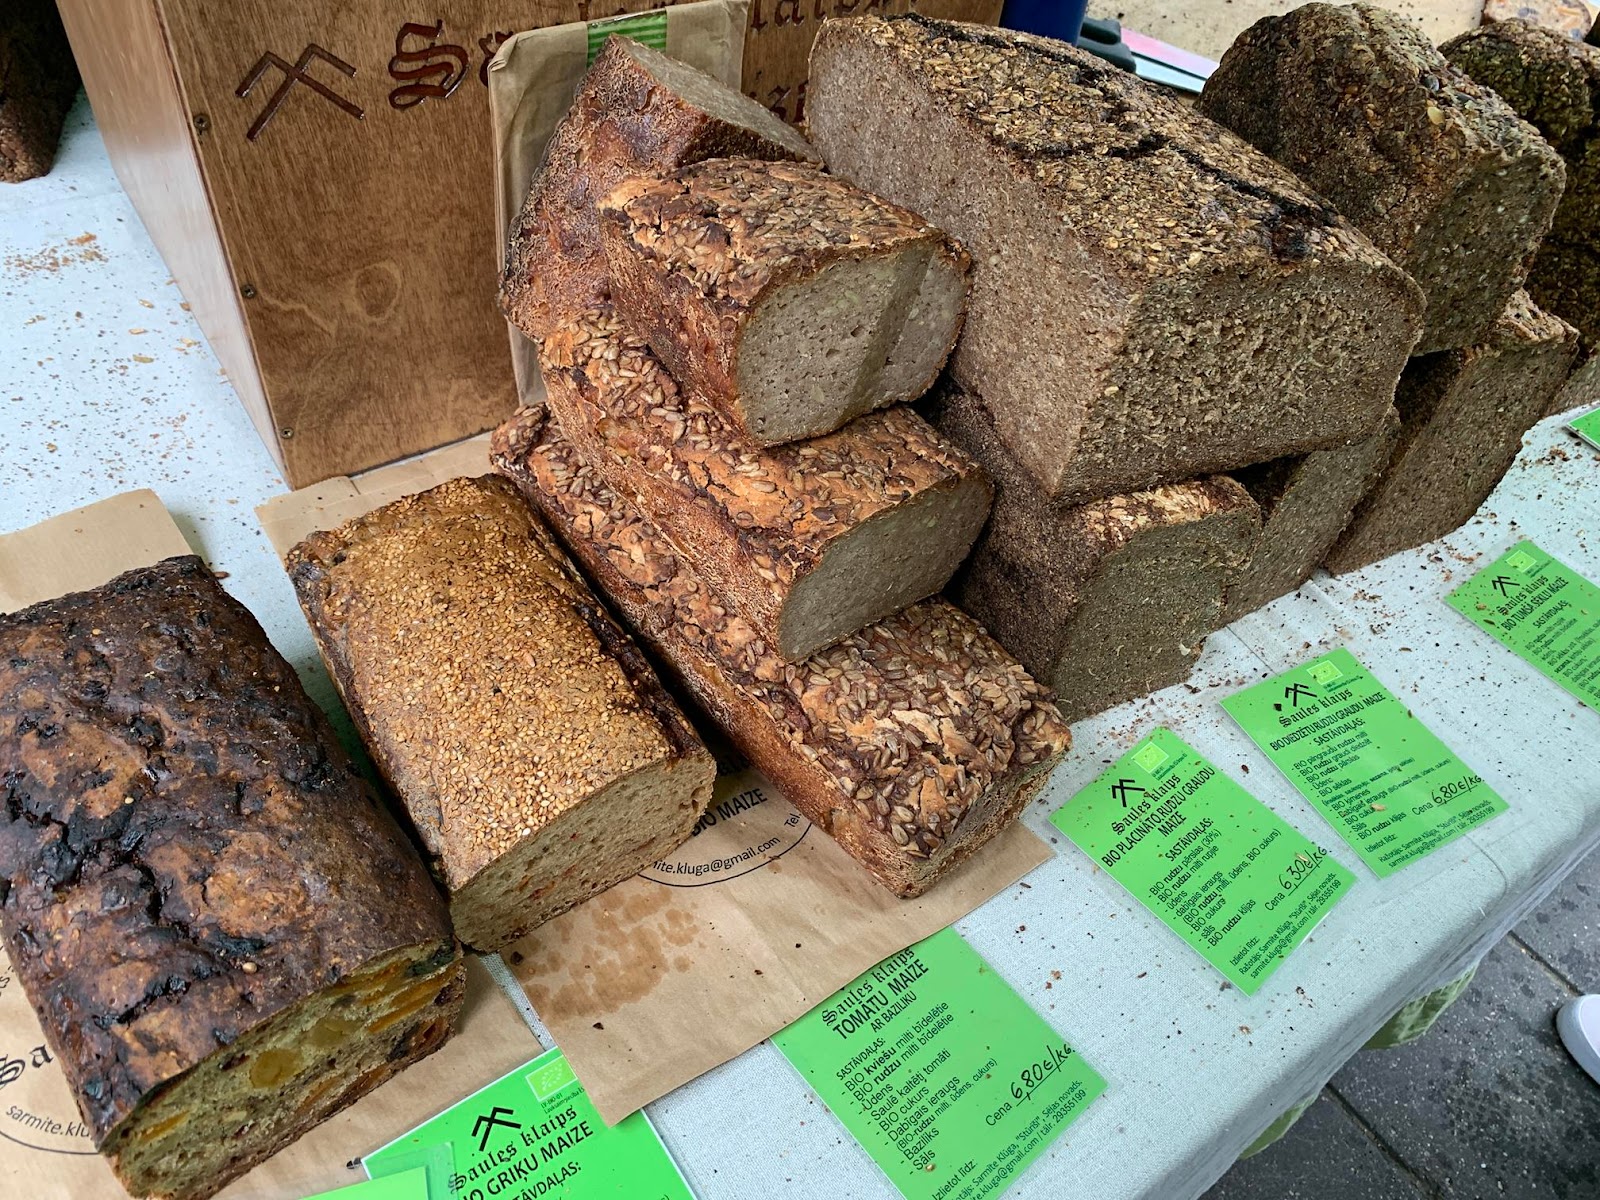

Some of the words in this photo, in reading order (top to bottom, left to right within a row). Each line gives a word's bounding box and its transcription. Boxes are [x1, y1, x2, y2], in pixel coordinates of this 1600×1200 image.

[1500, 618, 1517, 631] BIO
[1269, 739, 1285, 751] BIO
[1311, 713, 1339, 731] RUDZU
[1335, 701, 1365, 720] GRAUDU
[1362, 691, 1386, 707] MAIZE
[1278, 703, 1320, 728] Saules
[1317, 688, 1353, 708] klaips
[1336, 737, 1356, 749] rudzu
[1313, 758, 1332, 770] rudzu
[1319, 764, 1339, 777] rudzu
[720, 788, 768, 821] MAIZE
[1101, 849, 1121, 867] BIO
[1115, 812, 1163, 855] PLACINĀTO
[1155, 790, 1186, 818] RUDZU
[1181, 766, 1215, 795] GRAUDU
[1111, 798, 1151, 835] Saules
[1145, 774, 1181, 802] klaips
[1363, 790, 1388, 806] ieraugs
[1411, 802, 1434, 815] Cena
[1466, 805, 1495, 824] 29355199
[783, 811, 803, 829] Tel.
[1157, 810, 1187, 837] MAIZE
[1164, 817, 1214, 862] SASTĀVDAĻAS:
[1357, 828, 1372, 840] BIO
[1371, 820, 1392, 833] rudzu
[652, 836, 781, 876] ite.kluga@gmail.com
[1149, 881, 1165, 896] BIO
[1163, 864, 1183, 884] rudzu
[1200, 828, 1222, 849] (30%)
[1157, 888, 1173, 903] BIO
[1171, 871, 1192, 891] rudzu
[1189, 858, 1204, 873] milti
[1175, 891, 1205, 917] dabīgais
[1198, 870, 1224, 893] ieraugs
[1182, 906, 1199, 926] (BIO
[1195, 890, 1219, 911] rudzu
[1245, 847, 1261, 861] BIO
[1258, 828, 1282, 850] cukurs)
[1315, 879, 1341, 906] 29355199
[1166, 890, 1188, 910] ūdens
[1190, 917, 1206, 932] BIO
[1204, 895, 1226, 920] cukurs
[1264, 892, 1286, 911] Cena
[1200, 924, 1216, 939] sāls
[1207, 931, 1223, 947] BIO
[1221, 913, 1242, 934] rudzu
[821, 979, 873, 1026] Saules
[870, 945, 915, 983] klaips
[832, 990, 889, 1039] TOMĀTU
[887, 958, 929, 996] MAIZE
[870, 1018, 885, 1033] AR
[880, 990, 917, 1023] BAZILIKU
[836, 1037, 886, 1081] SASTĀVDAĻAS:
[844, 1072, 865, 1092] BIO
[863, 1046, 897, 1075] kviešu
[895, 1029, 915, 1049] milti
[911, 1002, 949, 1033] bīdelētie
[852, 1082, 873, 1101] BIO
[873, 1059, 902, 1085] rudzu
[900, 1041, 920, 1062] milti
[916, 1013, 954, 1046] bīdelētie
[861, 1083, 894, 1110] Ūdens
[870, 1094, 899, 1121] Saulē
[922, 1047, 951, 1075] tomāti
[6, 1104, 91, 1138] sarmite.klu
[878, 1111, 899, 1132] BIO
[899, 1086, 929, 1114] cukurs
[887, 1104, 929, 1143] Dabīgais
[925, 1076, 960, 1107] ieraugs
[896, 1114, 936, 1153] (BIO-rudzu
[934, 1099, 952, 1117] milti,
[949, 1081, 974, 1102] ūdens,
[972, 1057, 998, 1082] cukurs)
[985, 1102, 1013, 1126] Cena
[449, 1141, 517, 1195] Saules
[520, 1105, 577, 1147] klaips
[487, 1153, 539, 1196] GRIĶU
[540, 1120, 594, 1163] MAIZE
[902, 1127, 939, 1161] Baziliks
[912, 1149, 935, 1170] Sāls
[955, 1184, 975, 1200] otājs:
[996, 1143, 1019, 1163] Klūga,
[1041, 1100, 1063, 1118] Sējas
[1058, 1080, 1083, 1103] novads.
[969, 1137, 1039, 1200] te.kluga@gmail.com
[1039, 1120, 1055, 1136] tālr.
[1052, 1089, 1086, 1123] 29355199
[513, 1161, 582, 1200] TĀVDAĻAS:
[931, 1174, 961, 1200] Izlietot
[957, 1158, 977, 1177] līdz:
